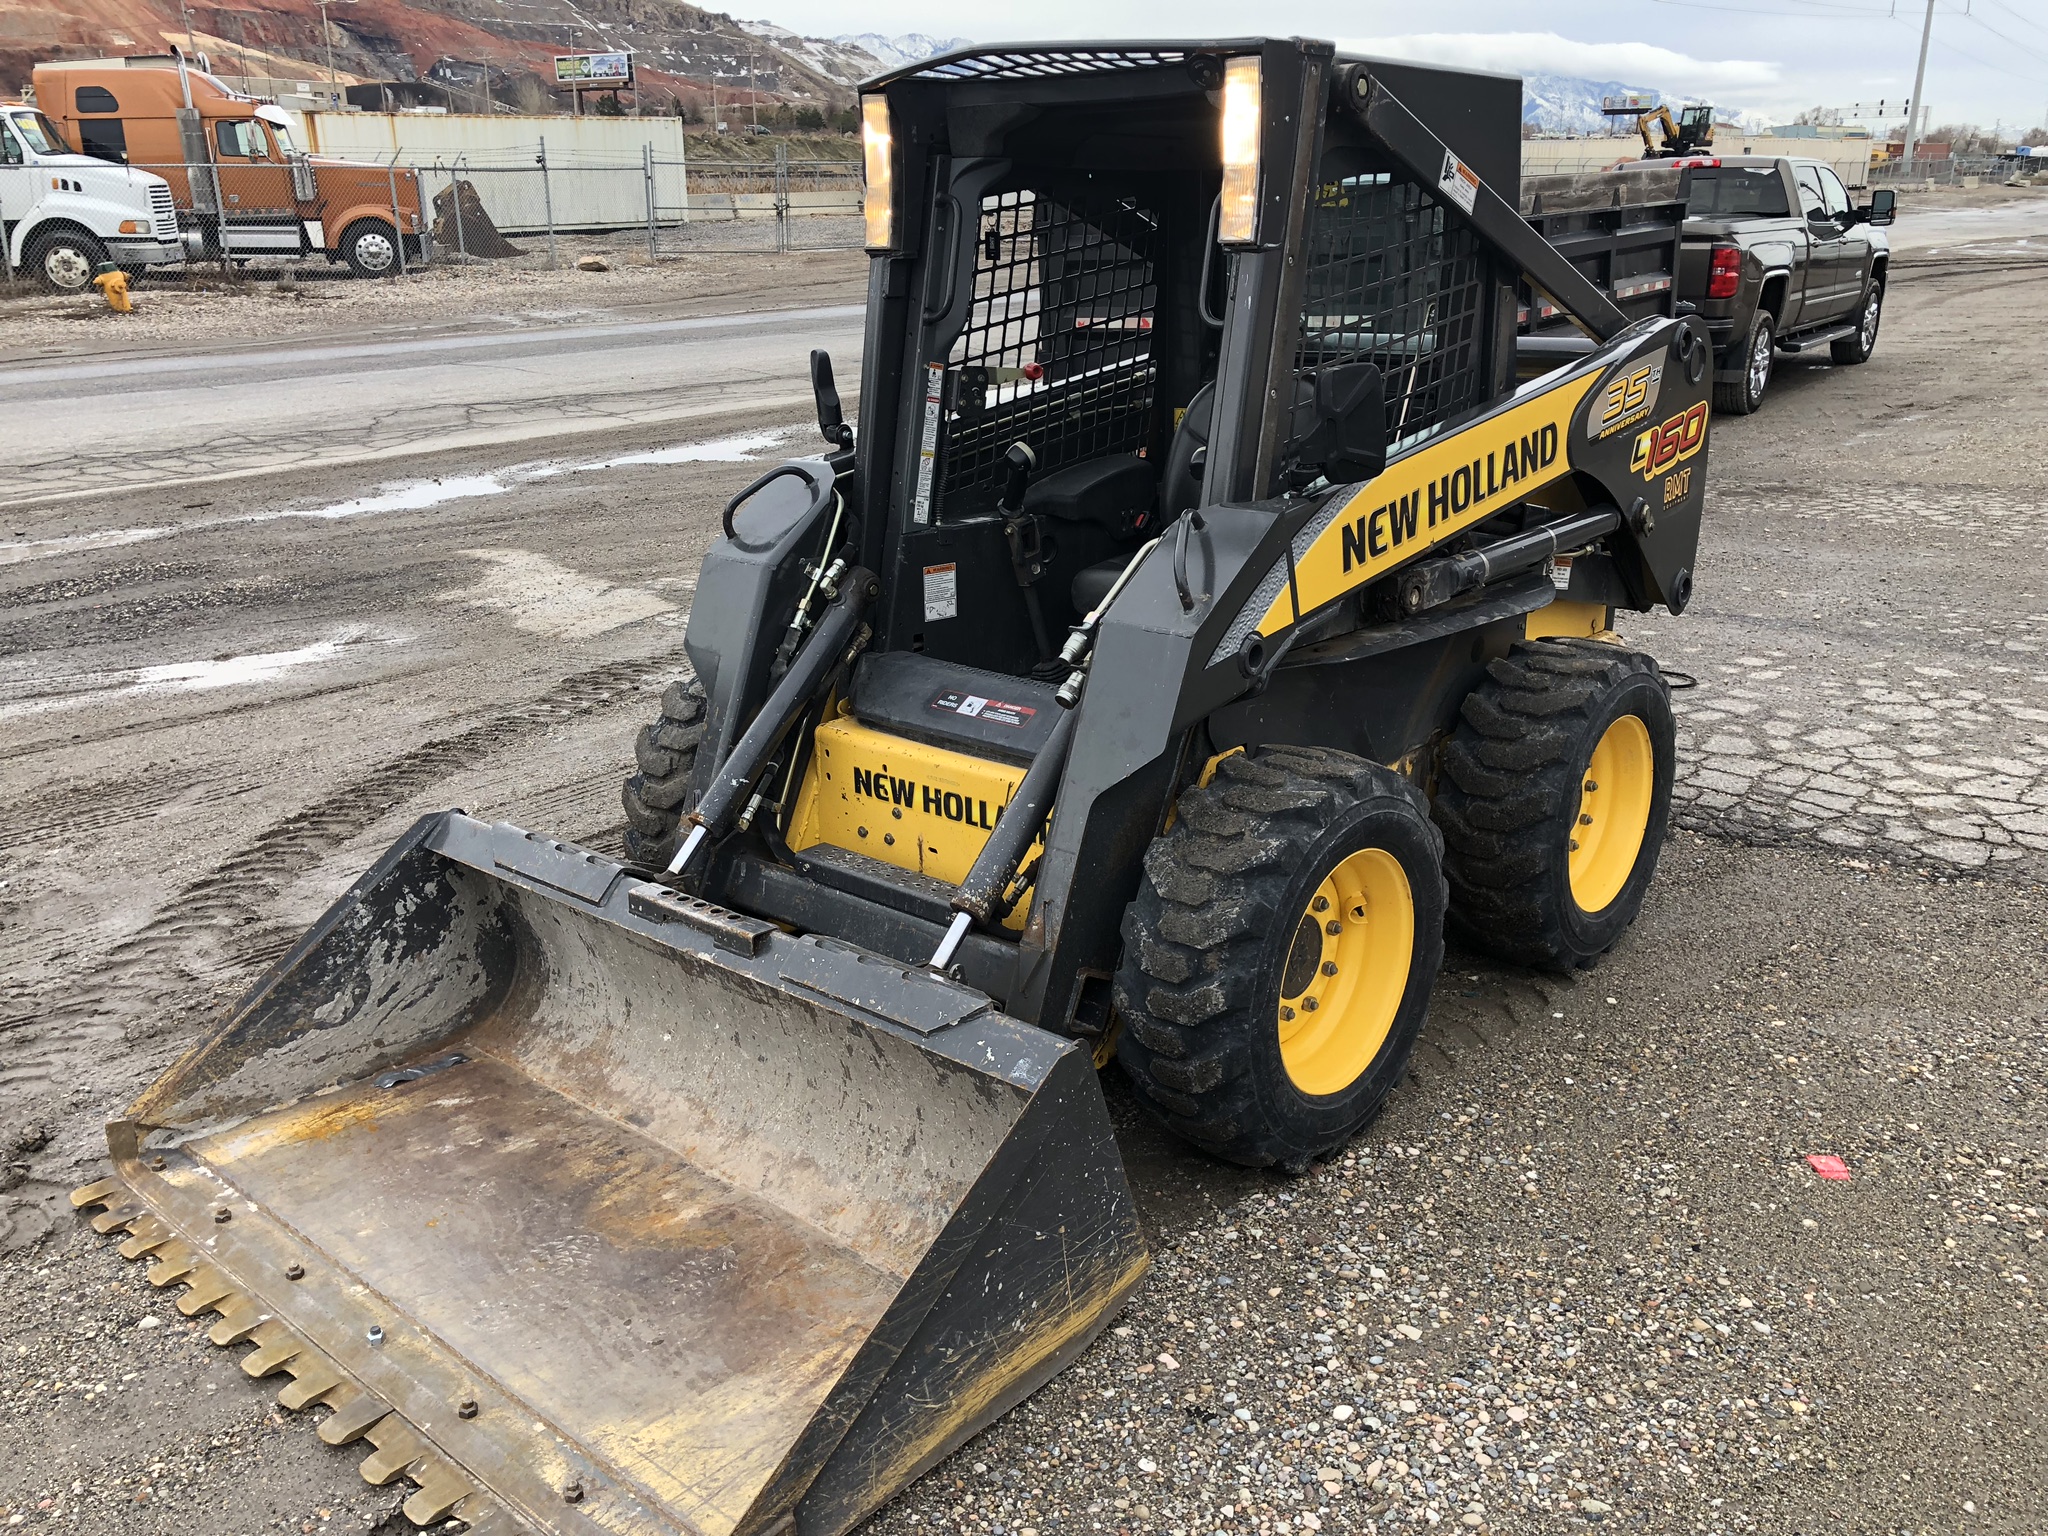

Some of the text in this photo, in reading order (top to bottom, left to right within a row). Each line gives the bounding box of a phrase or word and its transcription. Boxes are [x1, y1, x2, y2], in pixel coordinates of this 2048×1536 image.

[1599, 406, 1650, 439] ANNIVERSARY
[1630, 400, 1709, 482] L160
[1342, 421, 1558, 574] NEW HOLLAND
[1664, 467, 1691, 503] RMT
[937, 699, 959, 709] RIDERS
[853, 766, 915, 809] NEW
